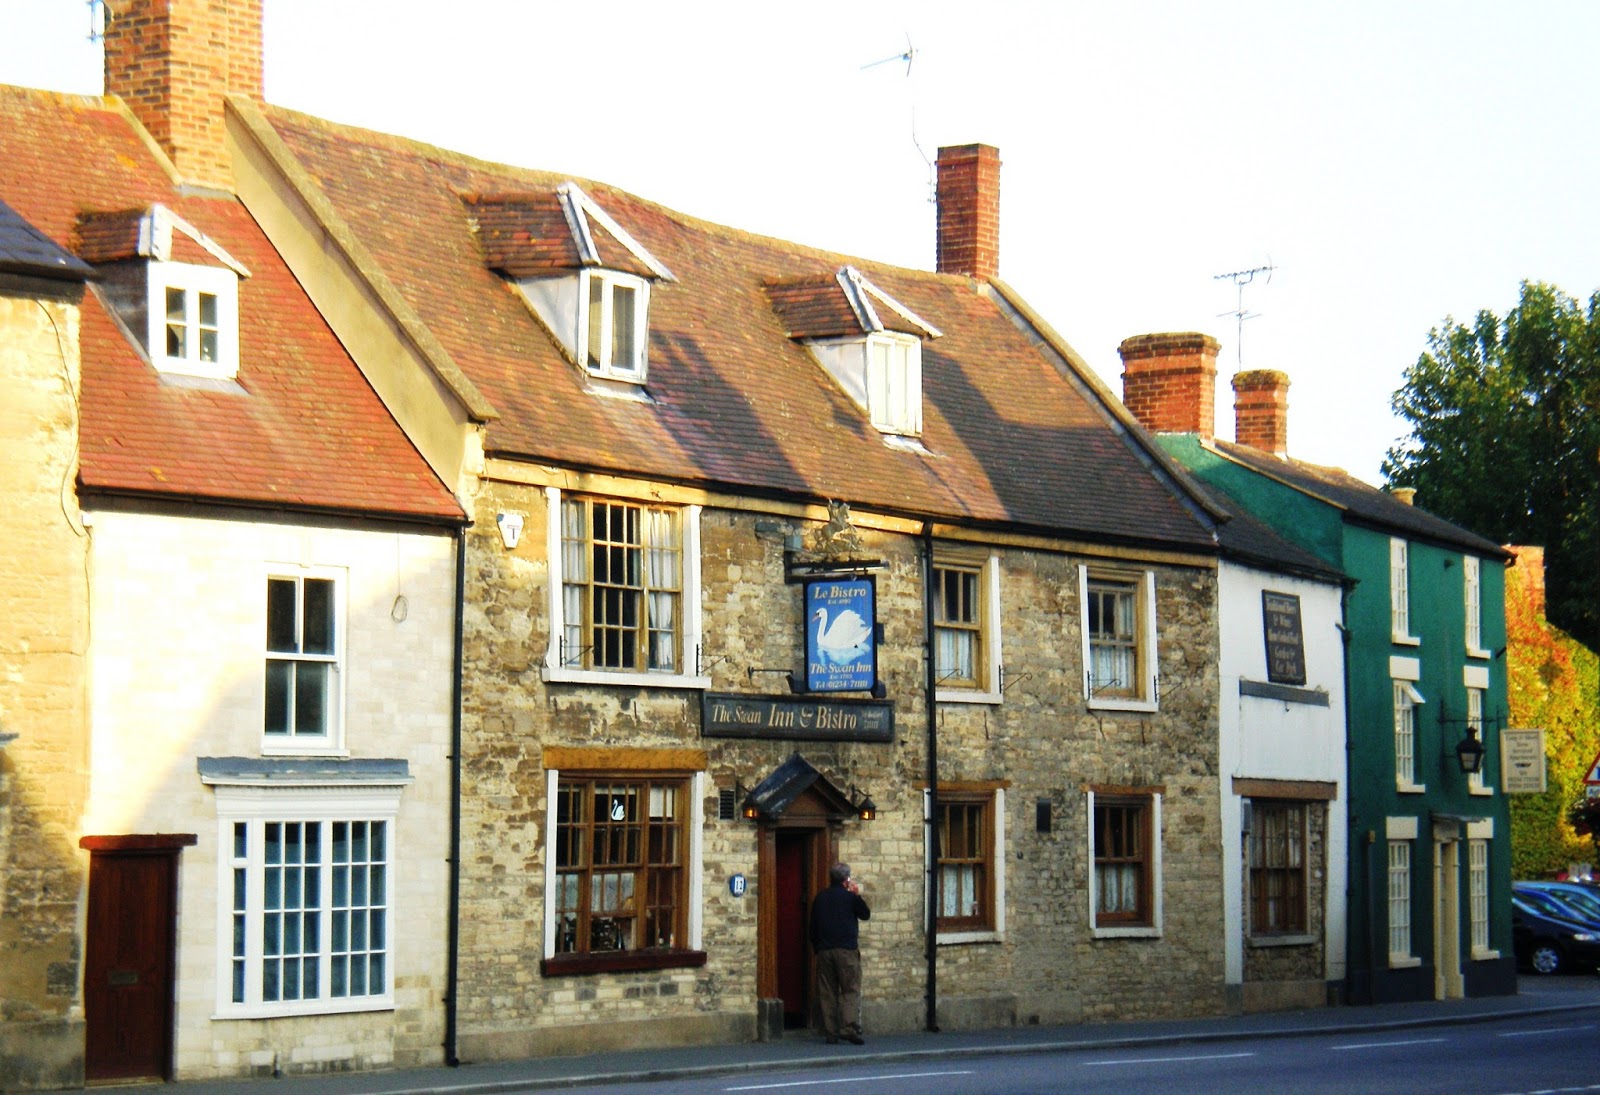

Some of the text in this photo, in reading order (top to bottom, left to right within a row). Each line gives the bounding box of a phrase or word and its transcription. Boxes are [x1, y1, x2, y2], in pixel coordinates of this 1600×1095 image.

[814, 585, 866, 599] Le Bistro
[810, 661, 872, 674] The Swan Inn
[712, 703, 731, 722] The
[733, 705, 761, 724] Swan
[768, 703, 794, 727] Inn
[800, 705, 814, 728] &
[816, 705, 857, 729] Bistro
